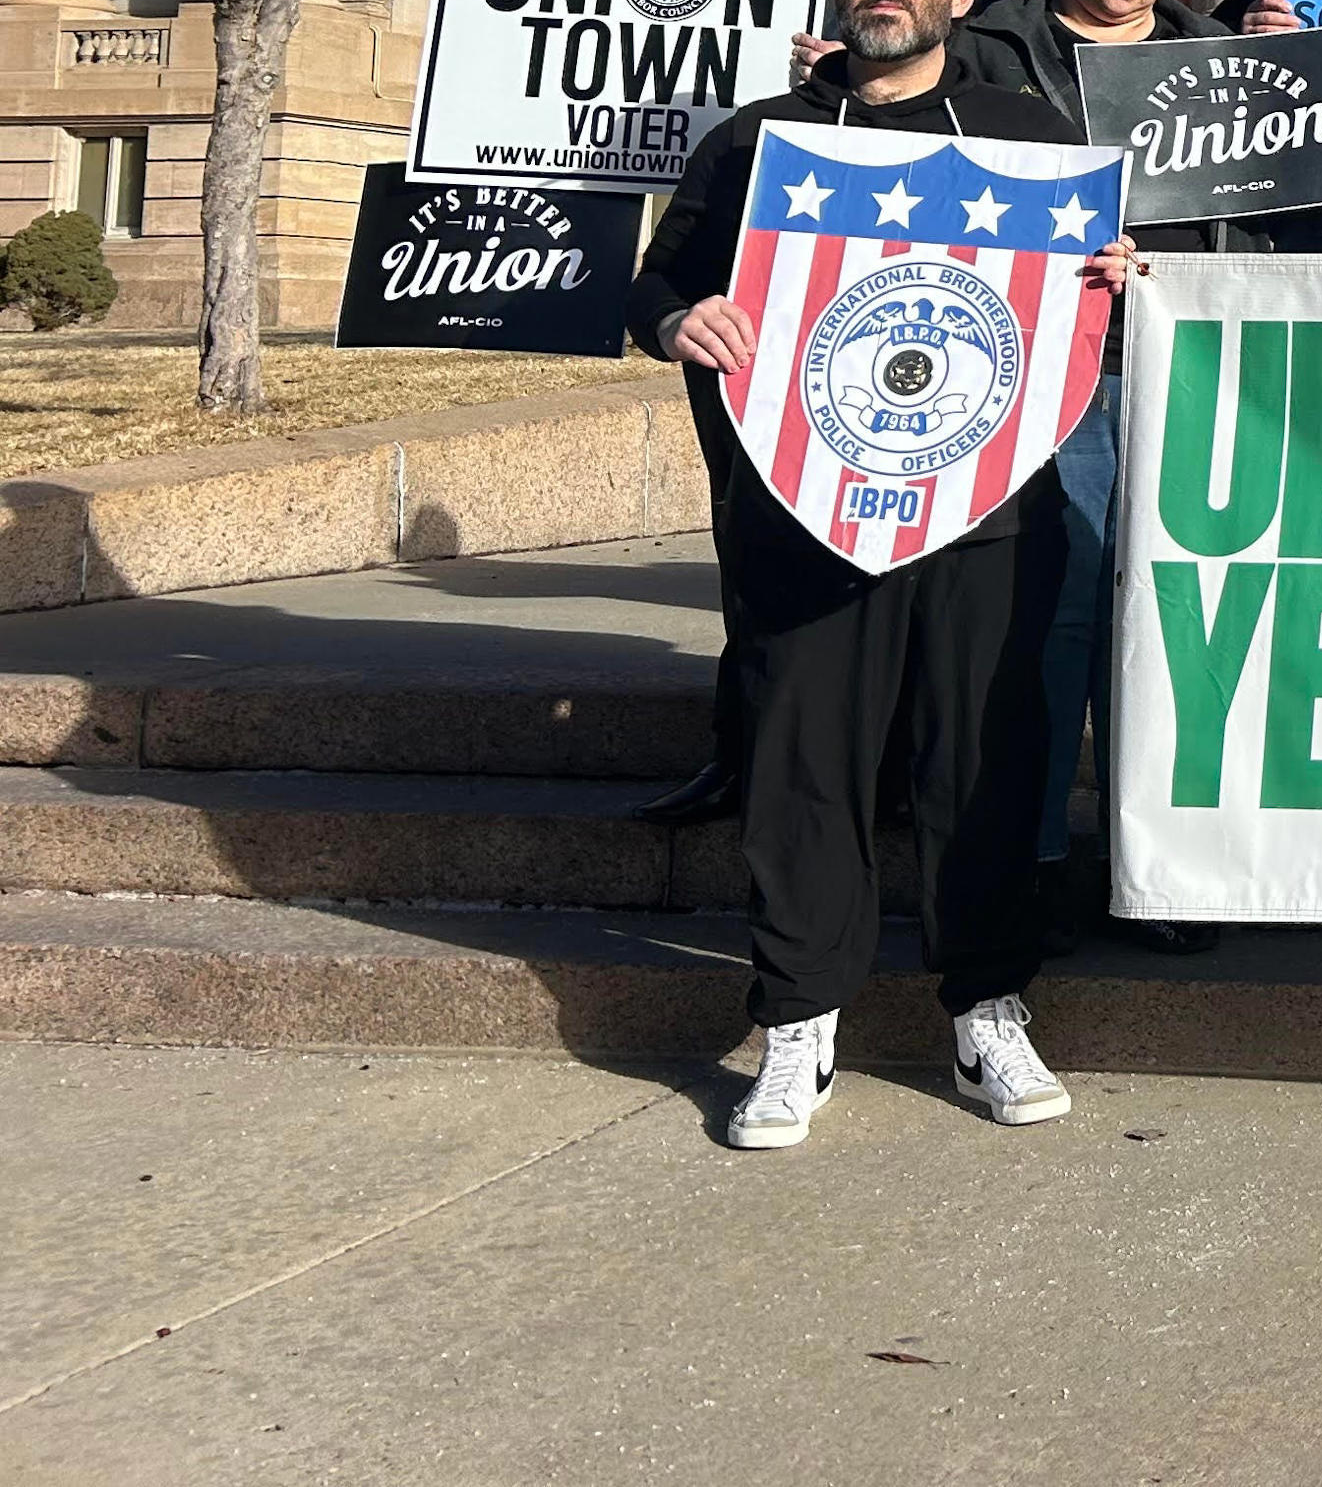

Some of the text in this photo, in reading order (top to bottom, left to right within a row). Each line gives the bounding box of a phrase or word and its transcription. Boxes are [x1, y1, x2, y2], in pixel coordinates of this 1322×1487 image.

[521, 16, 742, 108] TOWN
[1147, 56, 1308, 111] IT'S BETTER
[1209, 86, 1249, 104] IN A
[567, 103, 690, 152] VOTER
[1211, 179, 1275, 195] AFL-CIO
[409, 187, 571, 240] IT'S BETTER
[466, 215, 505, 232] IN A
[381, 236, 592, 301] Union
[438, 316, 503, 327] AFL-CIO
[809, 266, 1015, 387] INTERNATIONAL BROTHERHOOD
[815, 404, 991, 472] POLICE OFFICERS
[880, 414, 921, 431] 1964
[849, 486, 918, 523] IBPO
